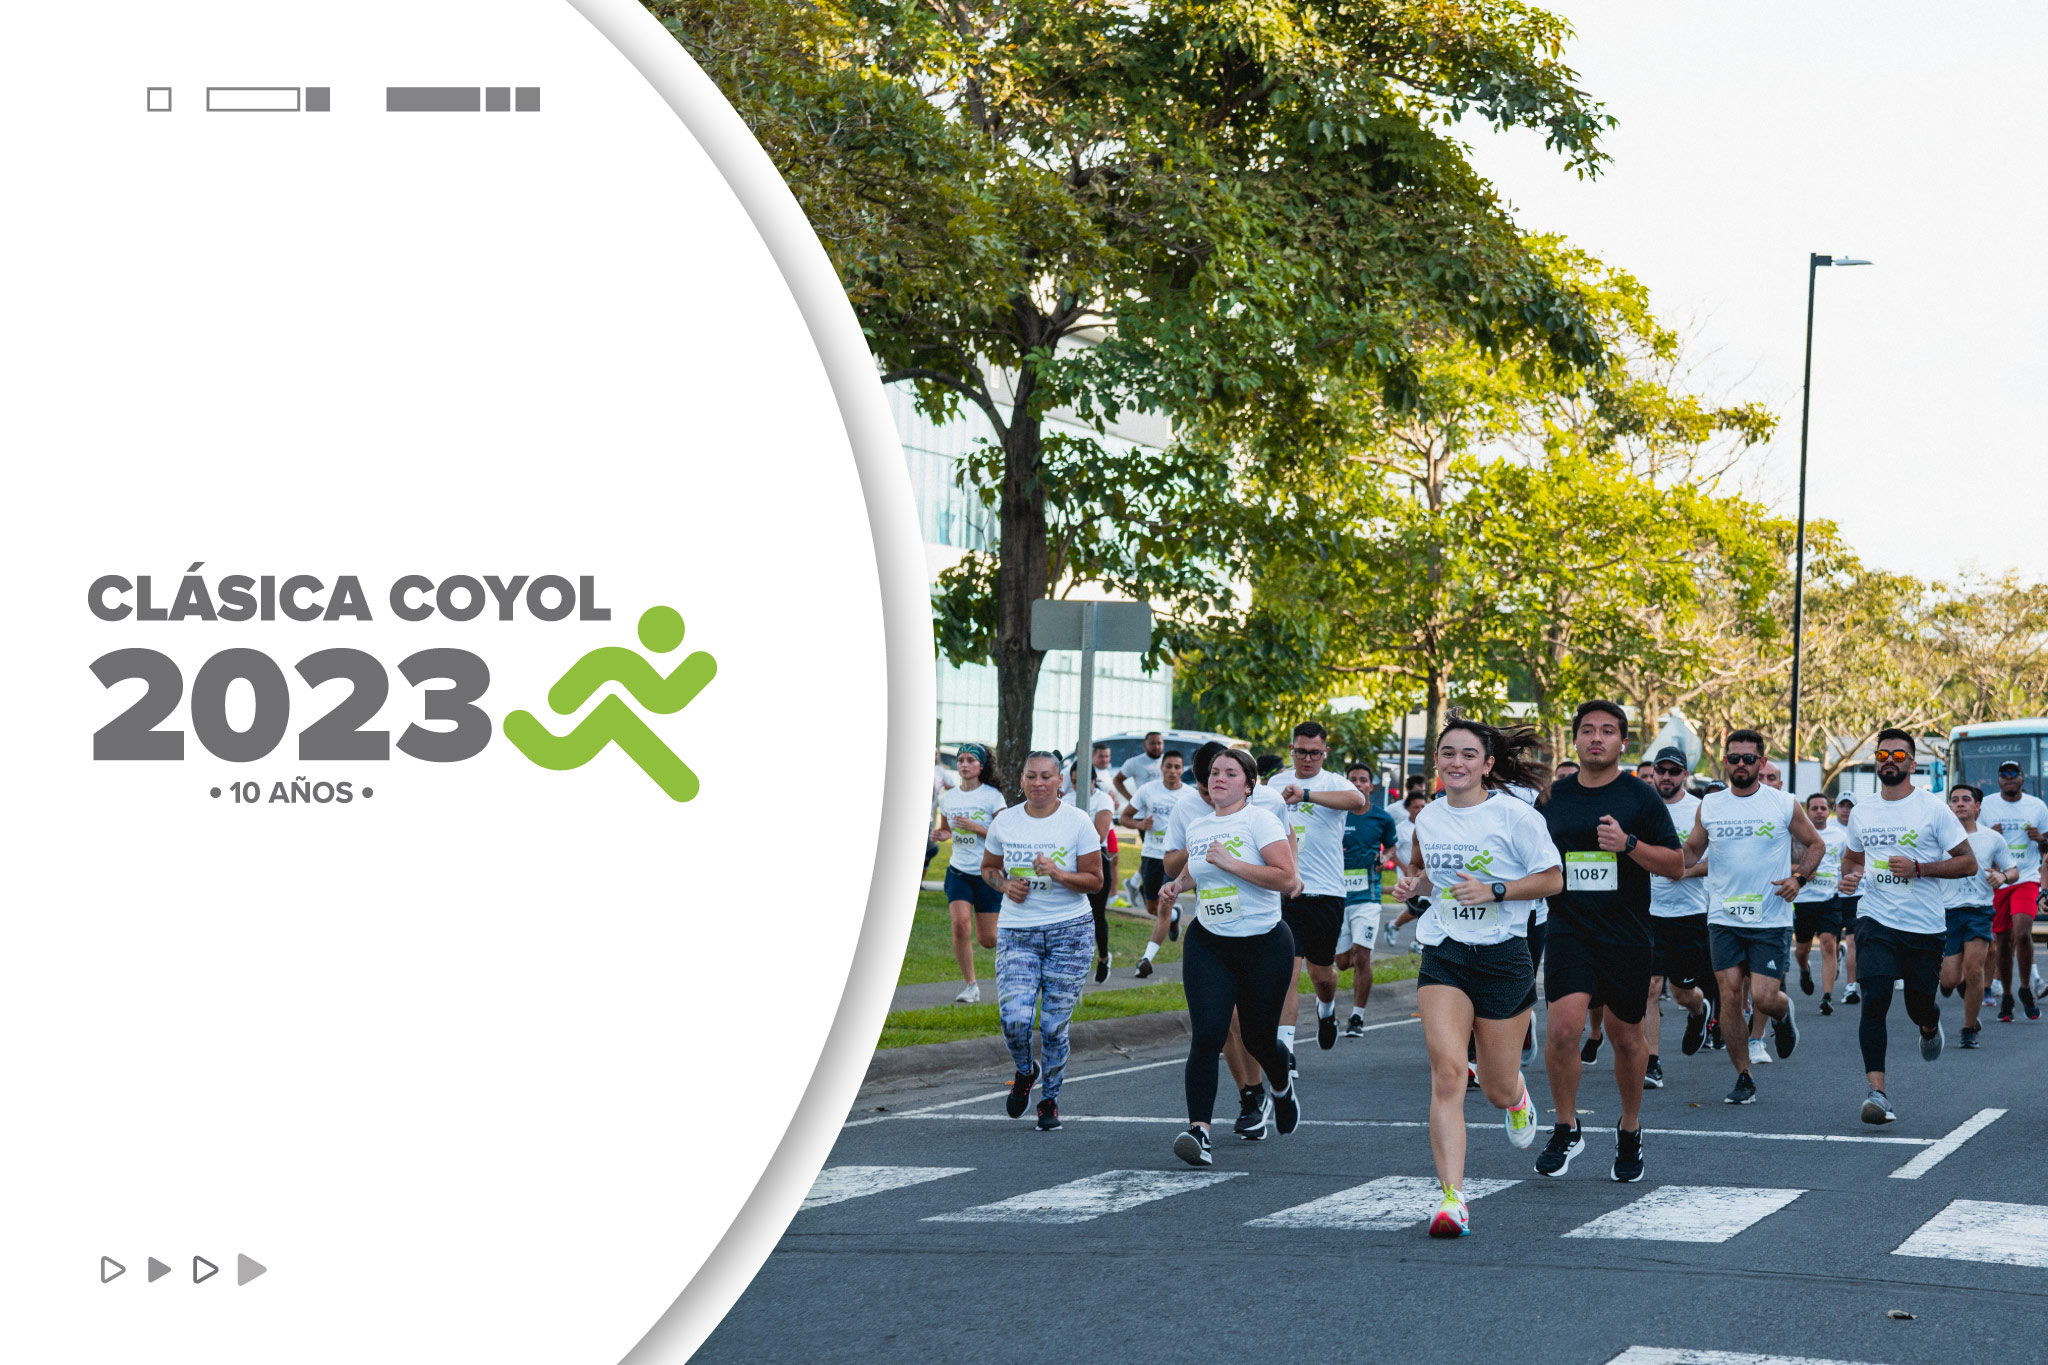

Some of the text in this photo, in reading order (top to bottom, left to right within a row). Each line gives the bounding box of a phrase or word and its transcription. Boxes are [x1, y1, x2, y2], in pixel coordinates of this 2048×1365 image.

[1152, 807, 1174, 815] 202
[1716, 826, 1753, 837] 2023
[1862, 834, 1897, 846] 2023
[1424, 842, 1451, 850] CLÁSICA
[1425, 853, 1464, 869] 2023
[1573, 869, 1608, 880] 1087
[1205, 902, 1233, 916] 1565
[1452, 907, 1486, 920] 1417
[1729, 907, 1755, 915] 2175
